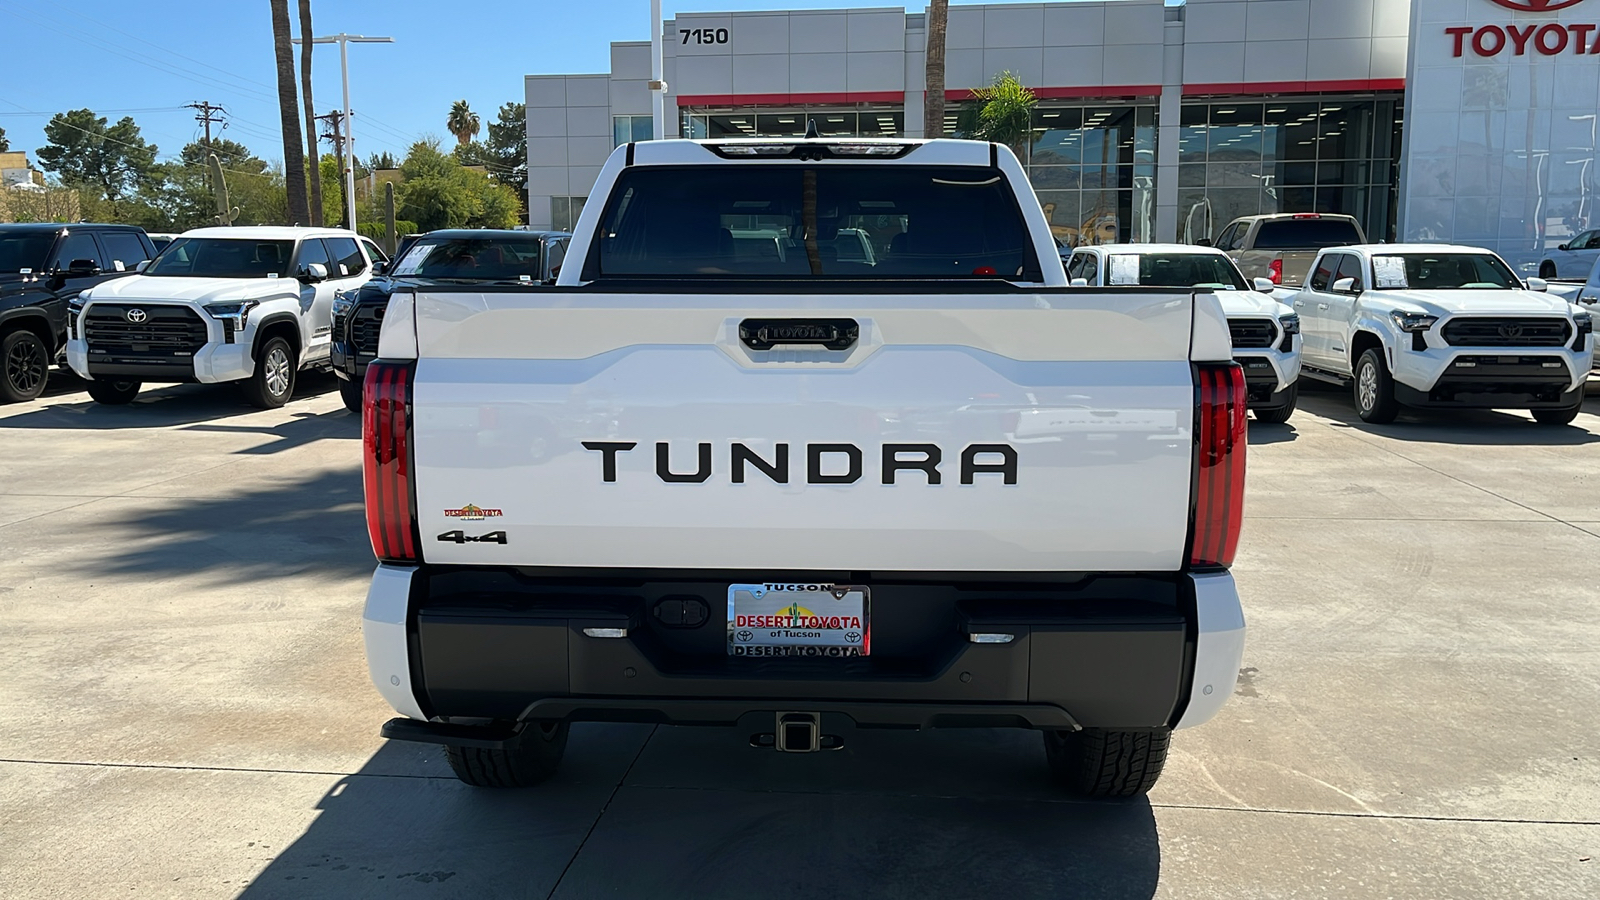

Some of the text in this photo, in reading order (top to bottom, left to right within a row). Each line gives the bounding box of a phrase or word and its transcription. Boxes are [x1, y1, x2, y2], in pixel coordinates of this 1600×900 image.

[679, 28, 729, 45] 7150
[771, 327, 827, 338] TOYOTA
[581, 441, 1018, 485] TUNDRA
[474, 509, 503, 517] TOYOTA
[764, 584, 832, 592] TUCSON
[736, 615, 861, 629] DESERT TOYOTA
[770, 630, 821, 638] of Tucson
[734, 645, 860, 657] DESERT TOYOTA
